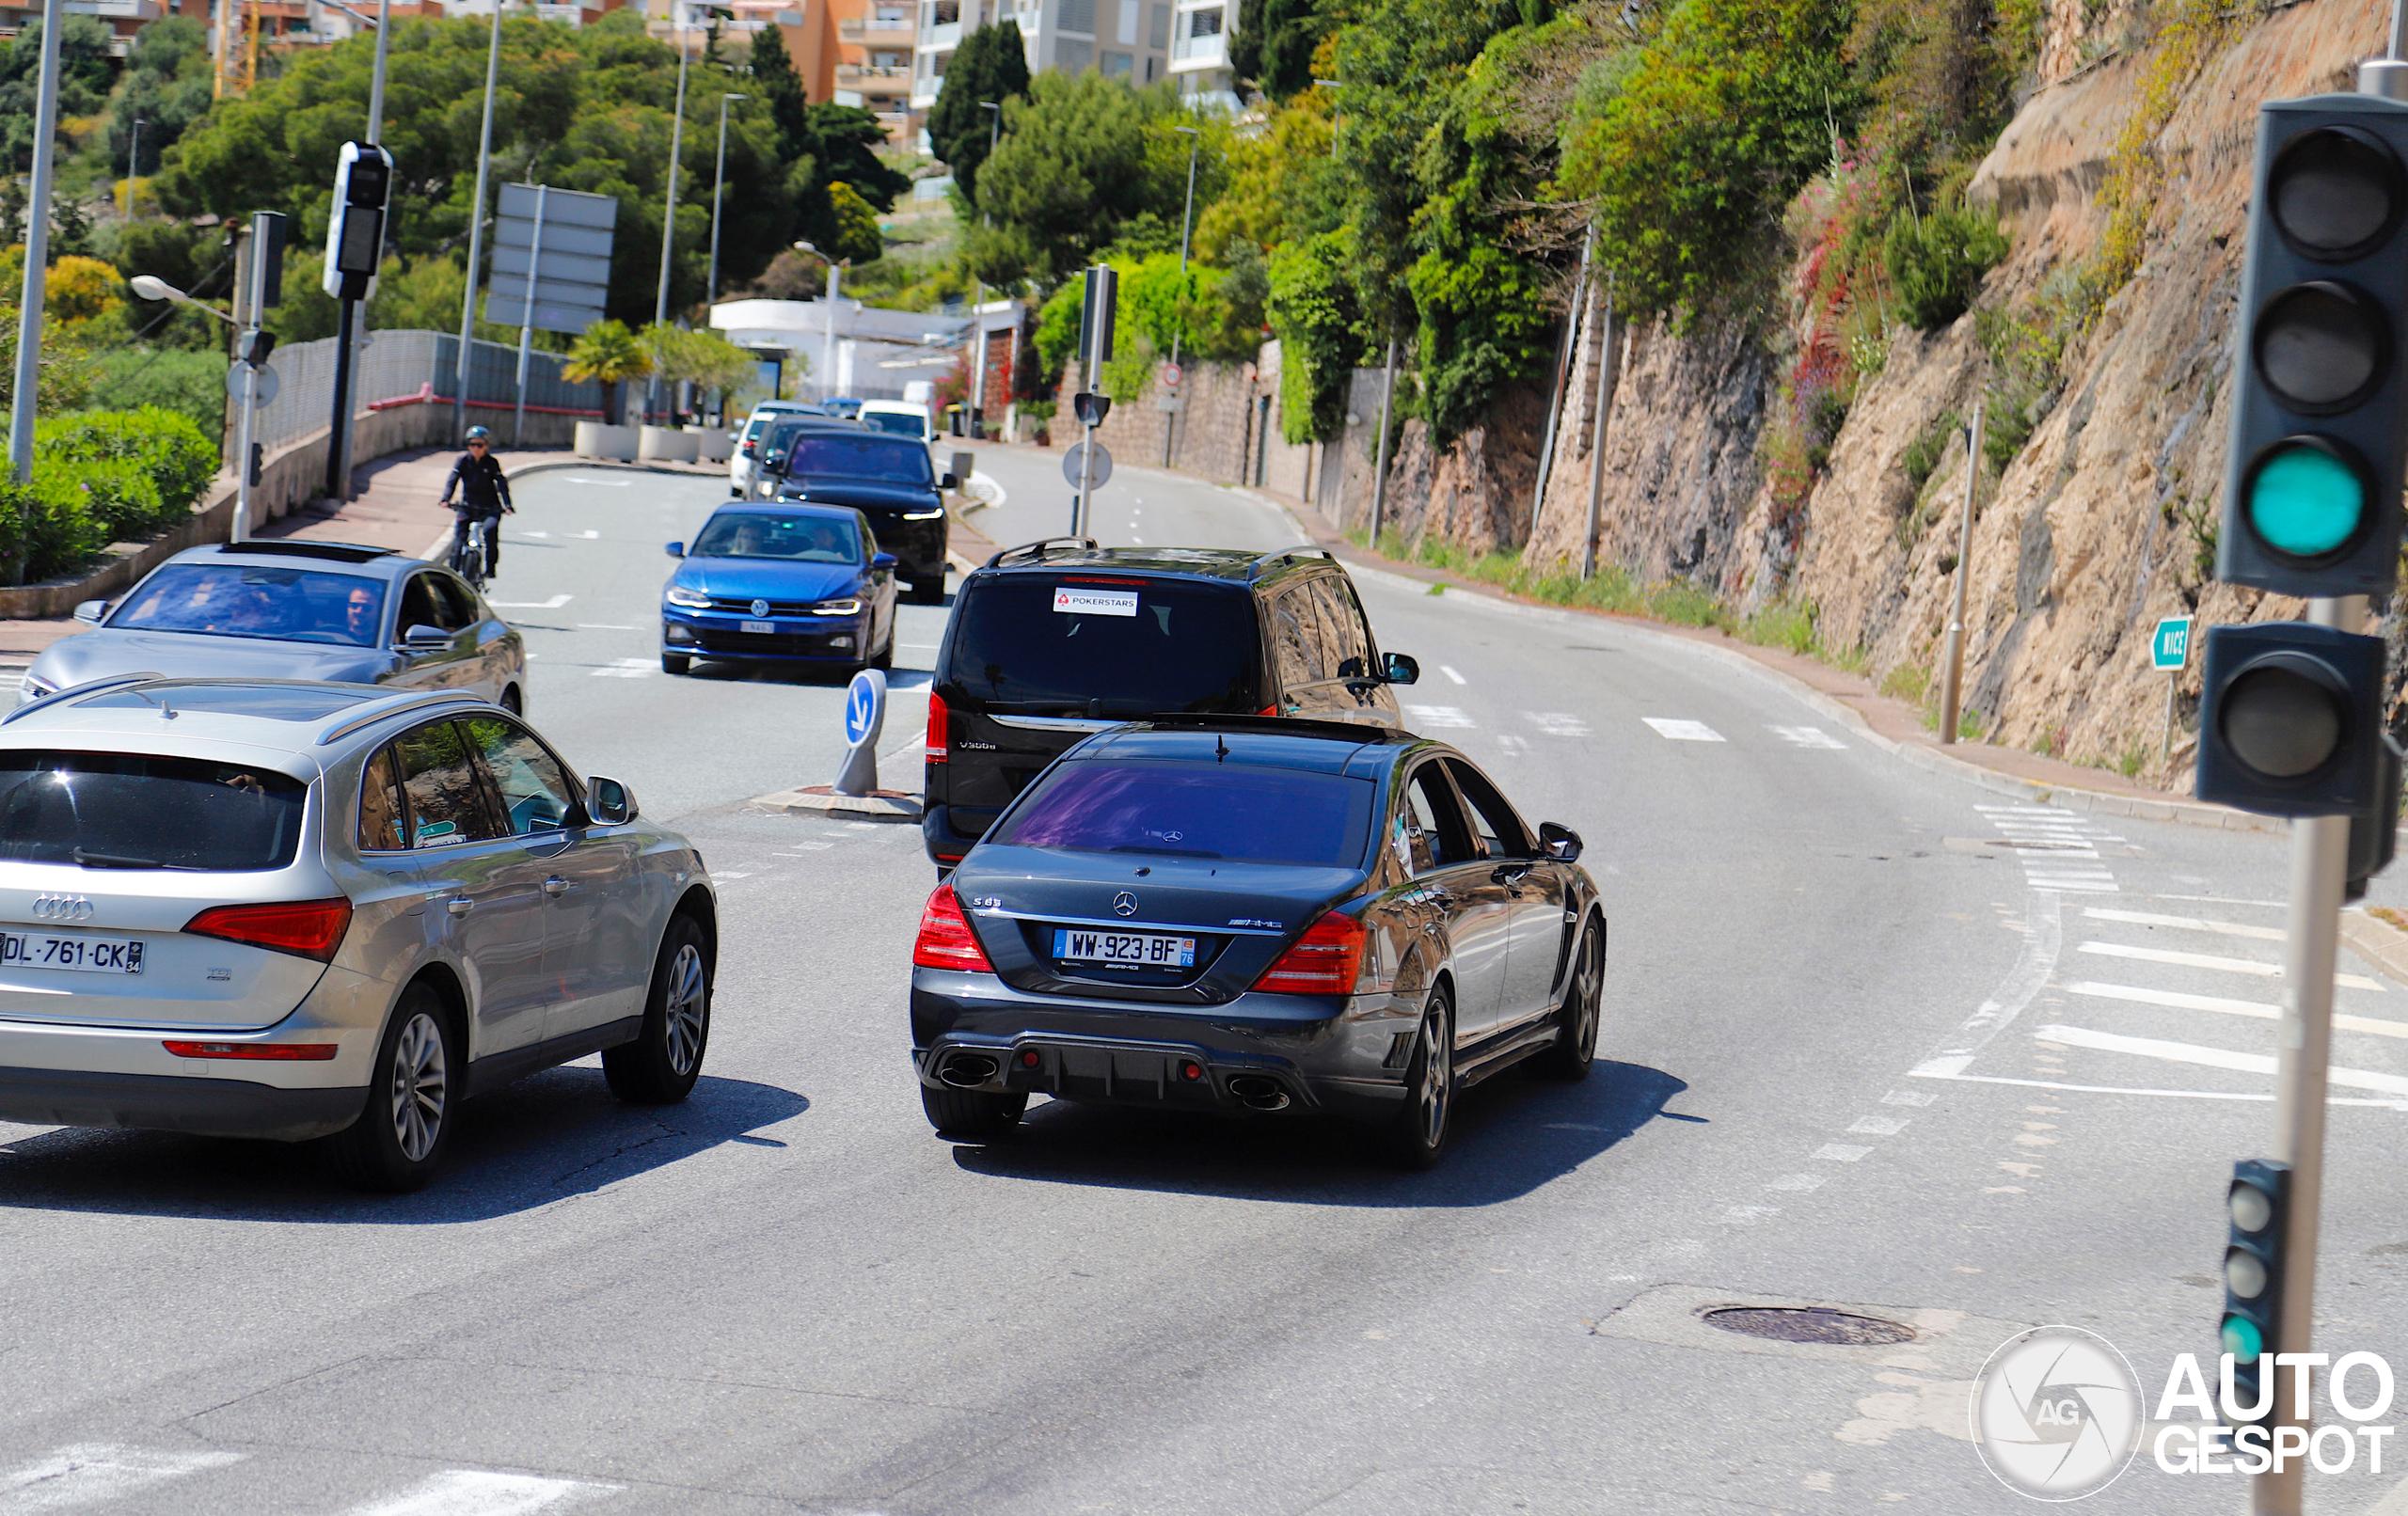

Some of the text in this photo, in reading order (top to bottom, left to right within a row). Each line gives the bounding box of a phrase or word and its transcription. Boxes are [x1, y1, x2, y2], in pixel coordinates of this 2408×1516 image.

[1072, 597, 1134, 608] POKERSTARS
[2162, 630, 2184, 655] NICE
[4, 937, 126, 968] DL-761-CK
[1072, 933, 1178, 962] WW-923-BF
[126, 960, 141, 972] 34
[1181, 953, 1194, 965] 76
